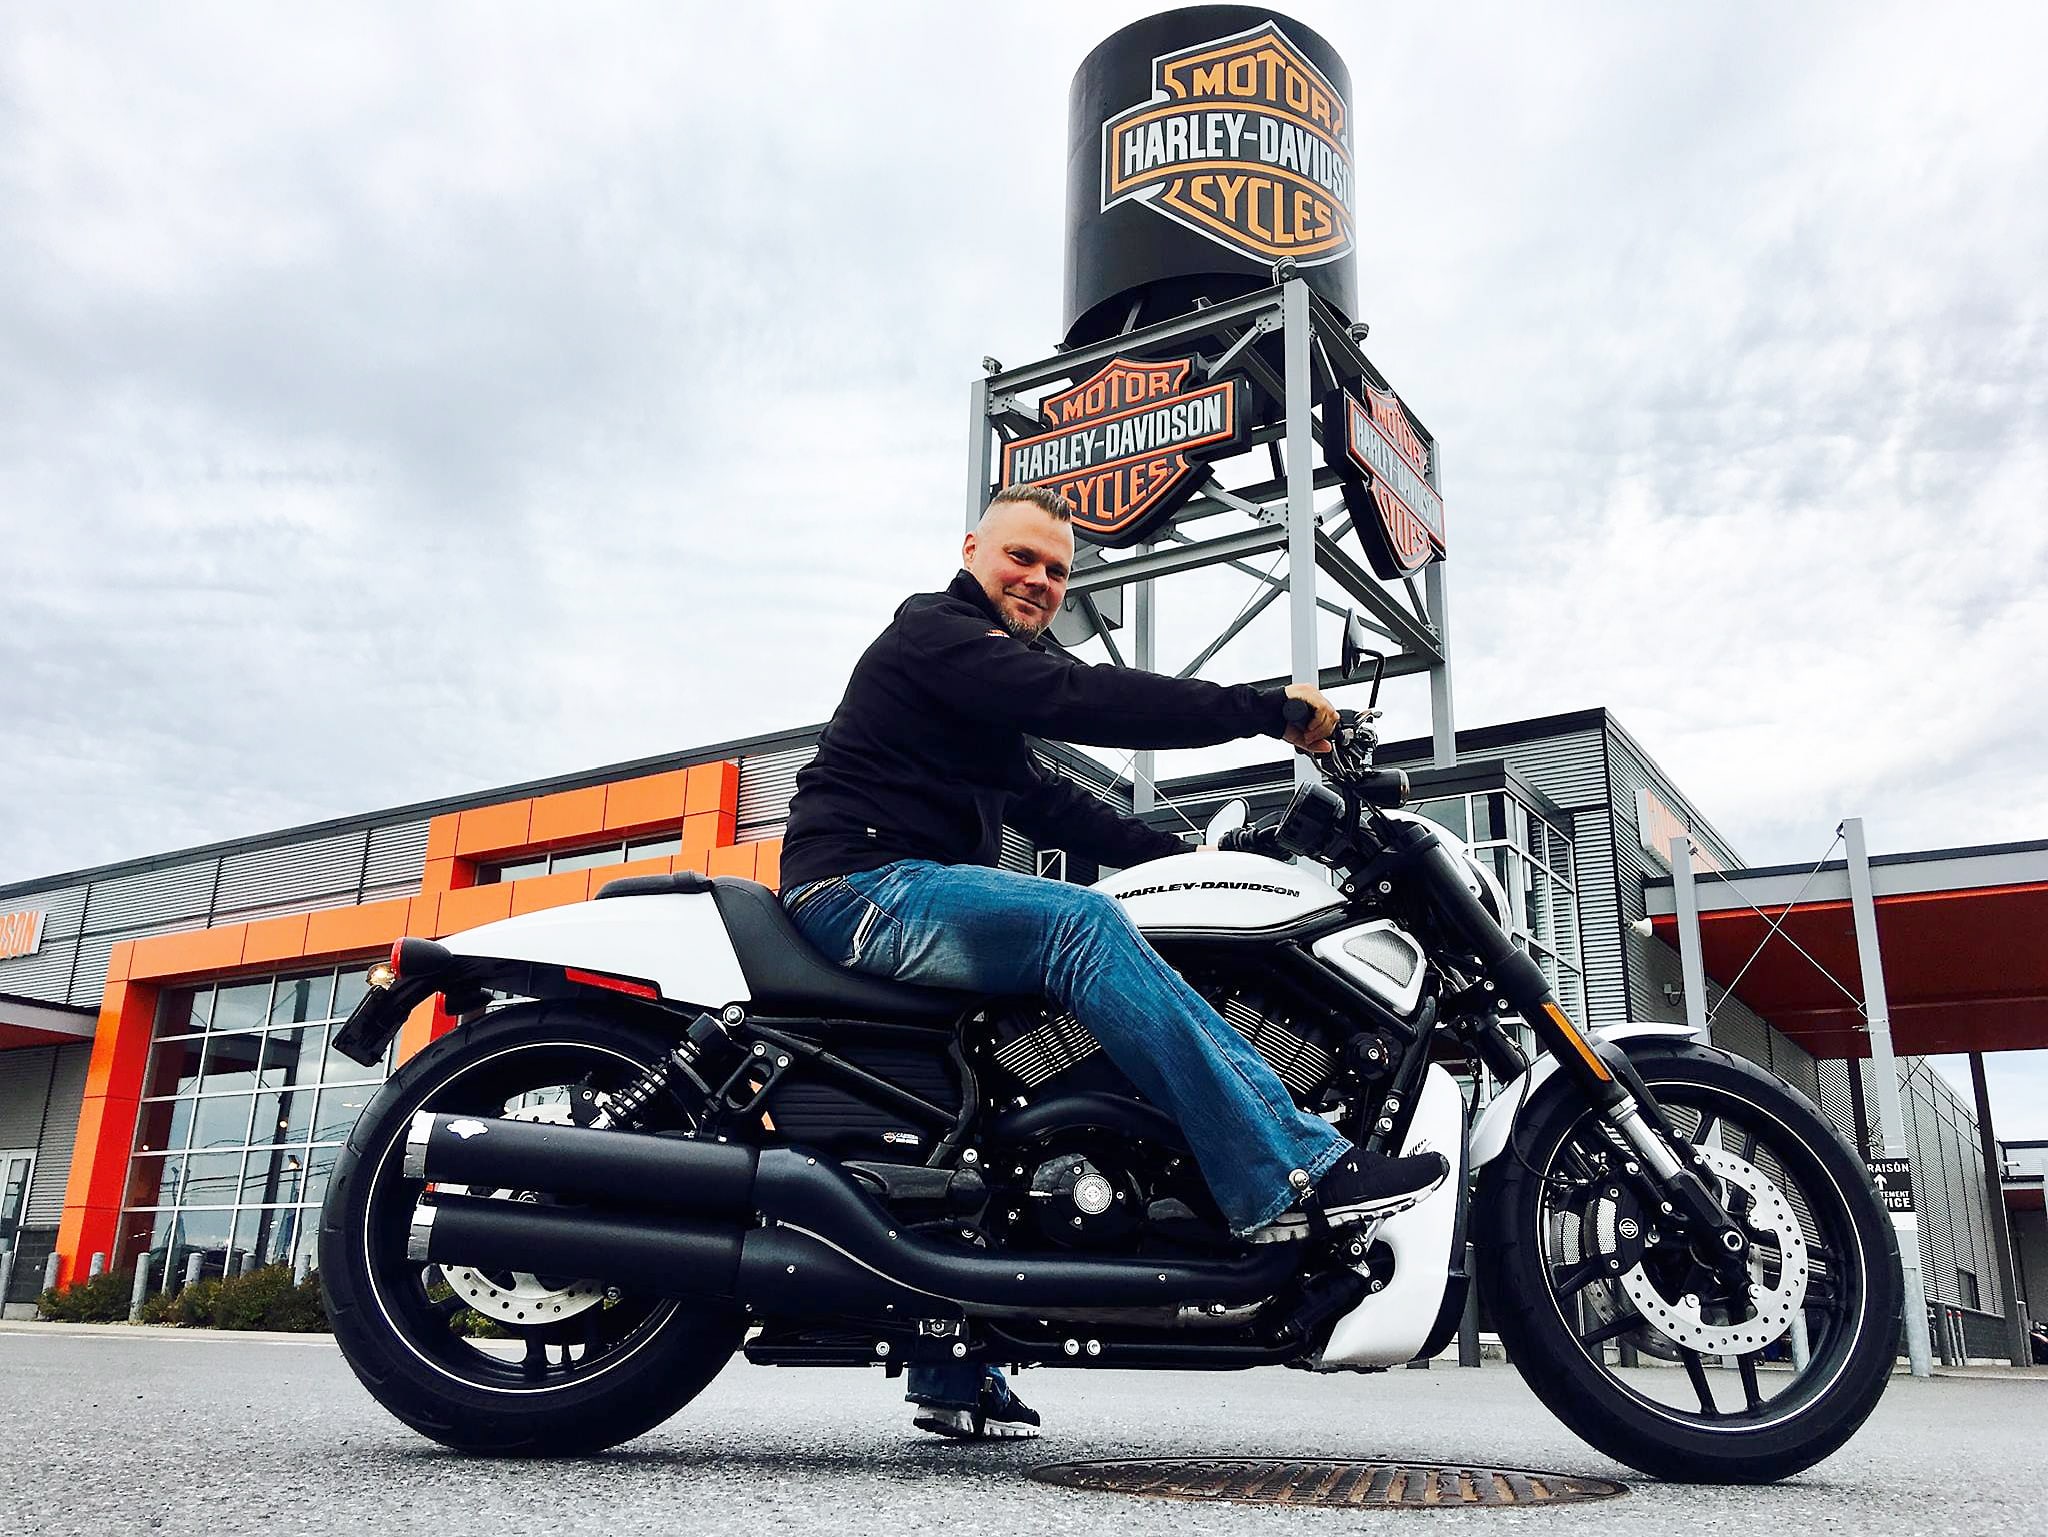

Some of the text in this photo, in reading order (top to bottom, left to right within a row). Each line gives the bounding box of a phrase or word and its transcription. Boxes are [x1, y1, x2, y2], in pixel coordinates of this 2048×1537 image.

[1192, 48, 1330, 129] MOTOR
[1124, 112, 1355, 218] HARLEY-DAVIDSO
[1190, 175, 1332, 244] CYCLES
[1062, 369, 1170, 428] MOTOR
[1014, 393, 1221, 485] HARLEY-DAVIDSON
[1060, 457, 1169, 521] CYCLES
[1114, 881, 1301, 900] HARLEY-DAVIDSON
